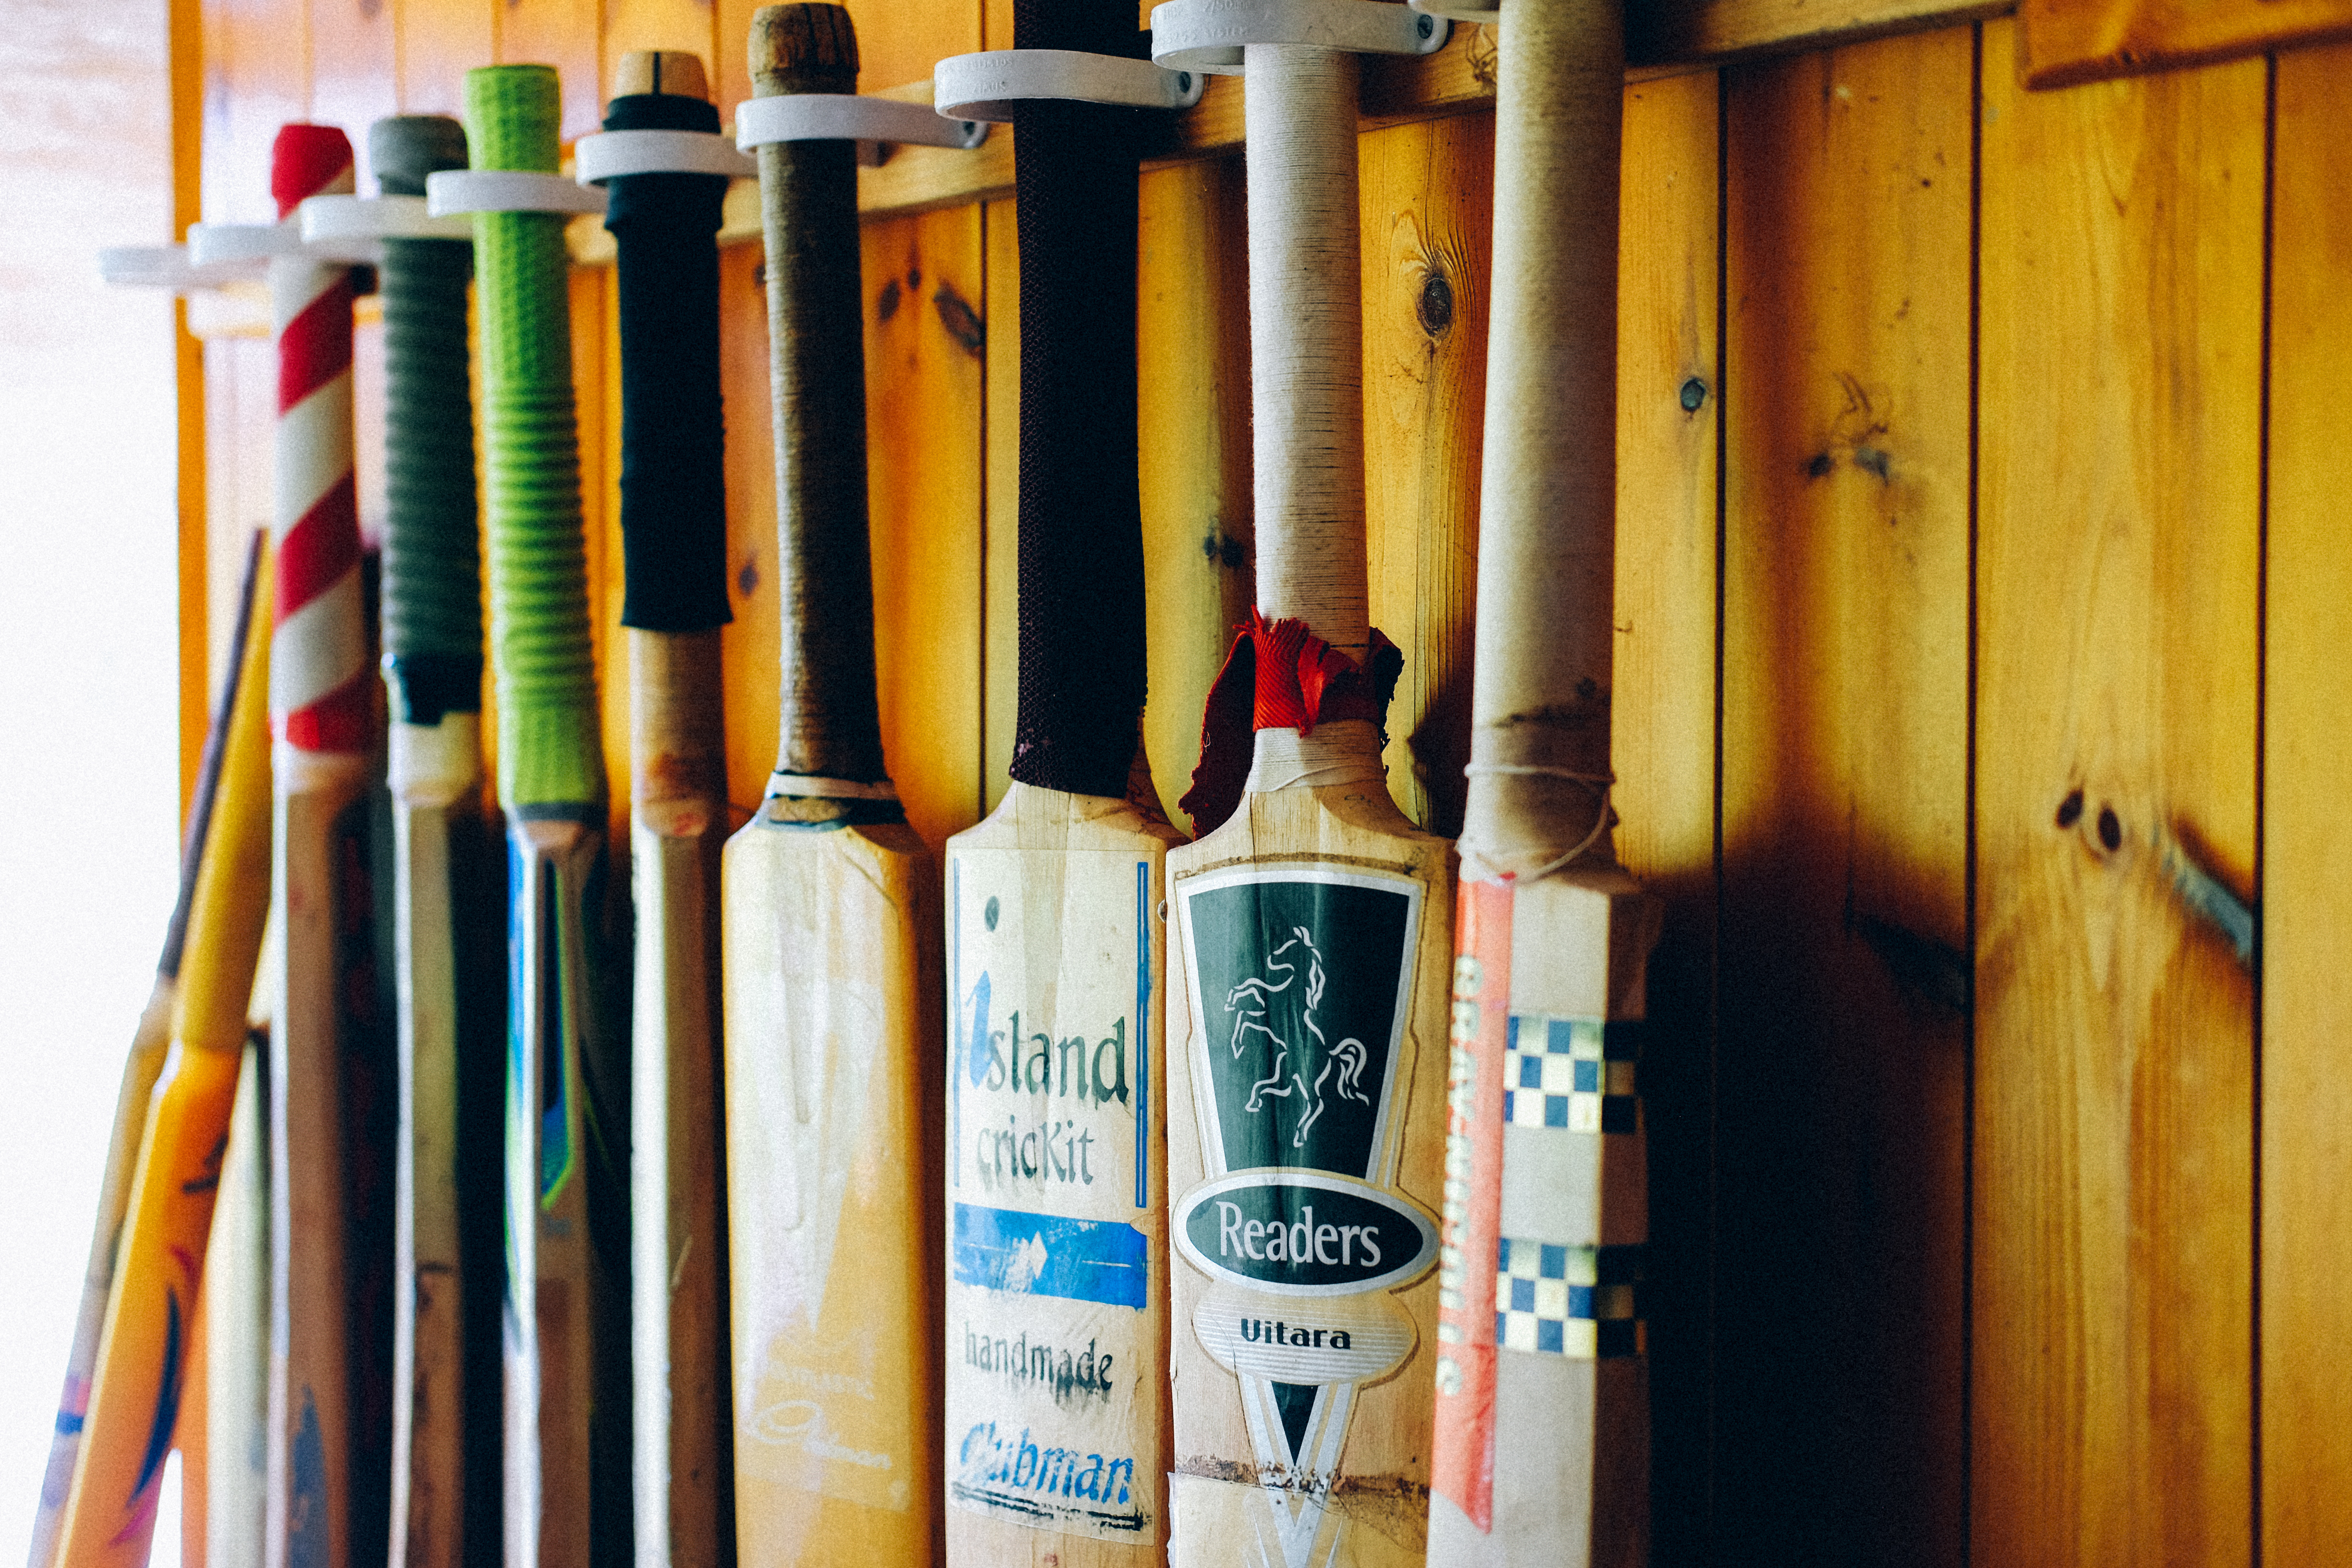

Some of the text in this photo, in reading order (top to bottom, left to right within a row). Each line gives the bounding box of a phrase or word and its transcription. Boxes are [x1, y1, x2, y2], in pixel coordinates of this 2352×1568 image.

[966, 970, 1129, 1103] Island
[1216, 1201, 1382, 1267] Readers
[964, 1320, 1113, 1393] handmade
[1241, 1318, 1351, 1350] Vitara
